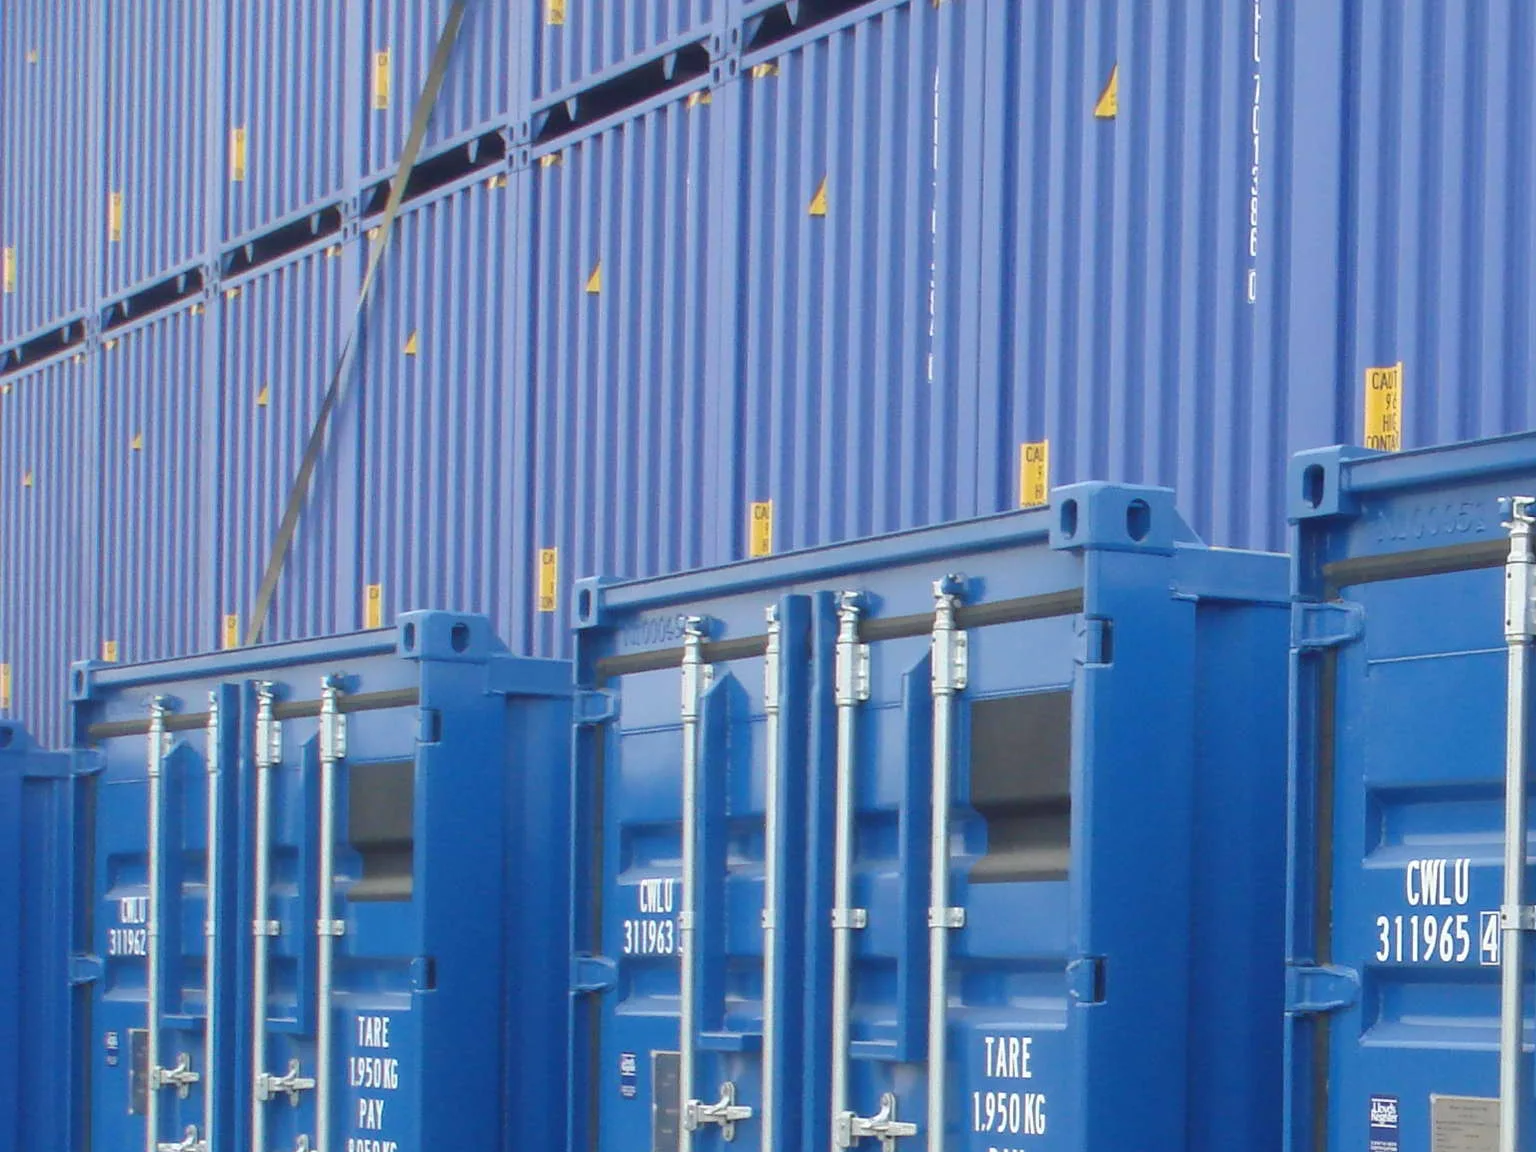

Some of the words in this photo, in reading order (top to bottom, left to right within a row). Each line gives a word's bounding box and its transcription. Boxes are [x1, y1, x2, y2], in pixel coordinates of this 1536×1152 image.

[641, 879, 673, 912] CWLU
[1406, 858, 1471, 905] CWLU
[624, 920, 673, 953] 311963
[1376, 915, 1470, 962] 311965
[358, 1016, 390, 1048] TARE
[984, 1036, 1033, 1079] TARE
[359, 1098, 384, 1130] PAY
